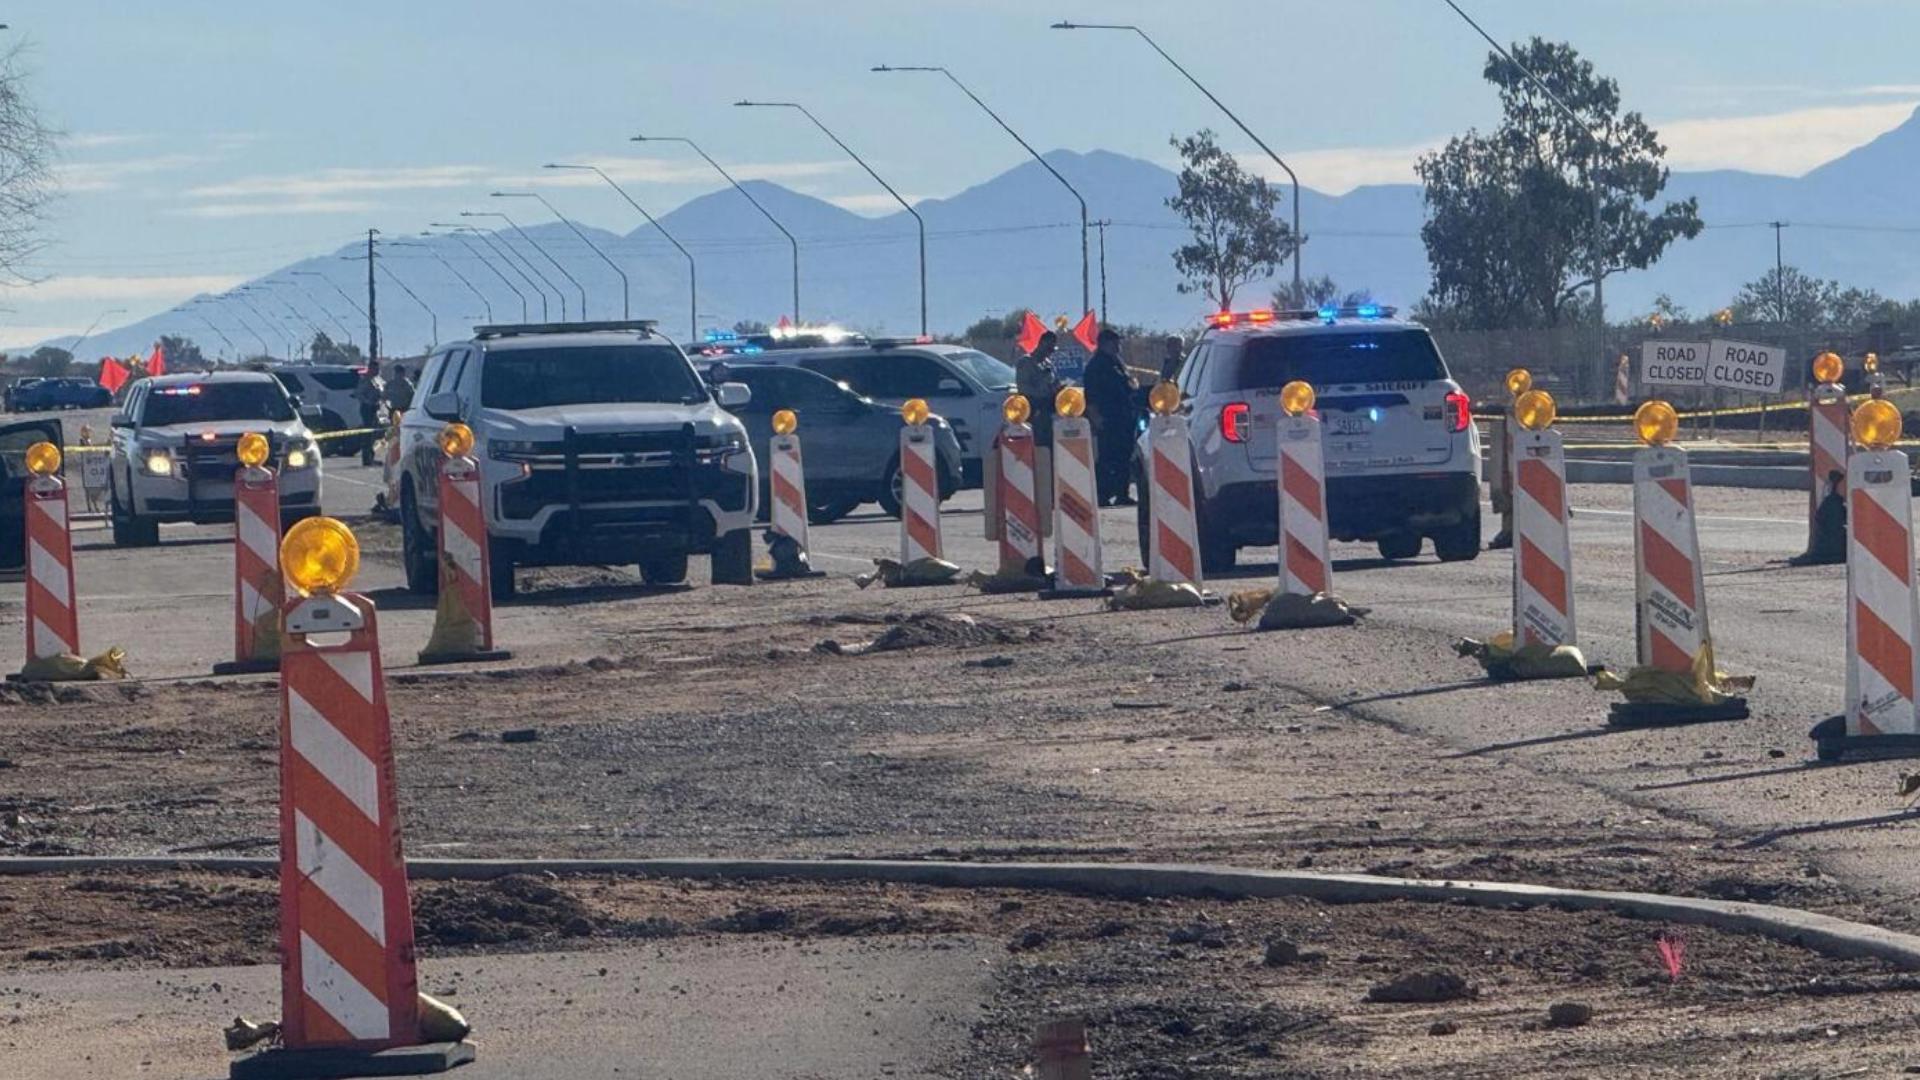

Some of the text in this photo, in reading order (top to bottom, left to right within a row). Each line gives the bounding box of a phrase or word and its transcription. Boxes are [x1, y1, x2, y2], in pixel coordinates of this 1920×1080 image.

[1657, 347, 1696, 361] ROAD
[1726, 347, 1768, 366] ROAD
[1649, 366, 1703, 380] CLOSED
[1714, 365, 1774, 387] CLOSED
